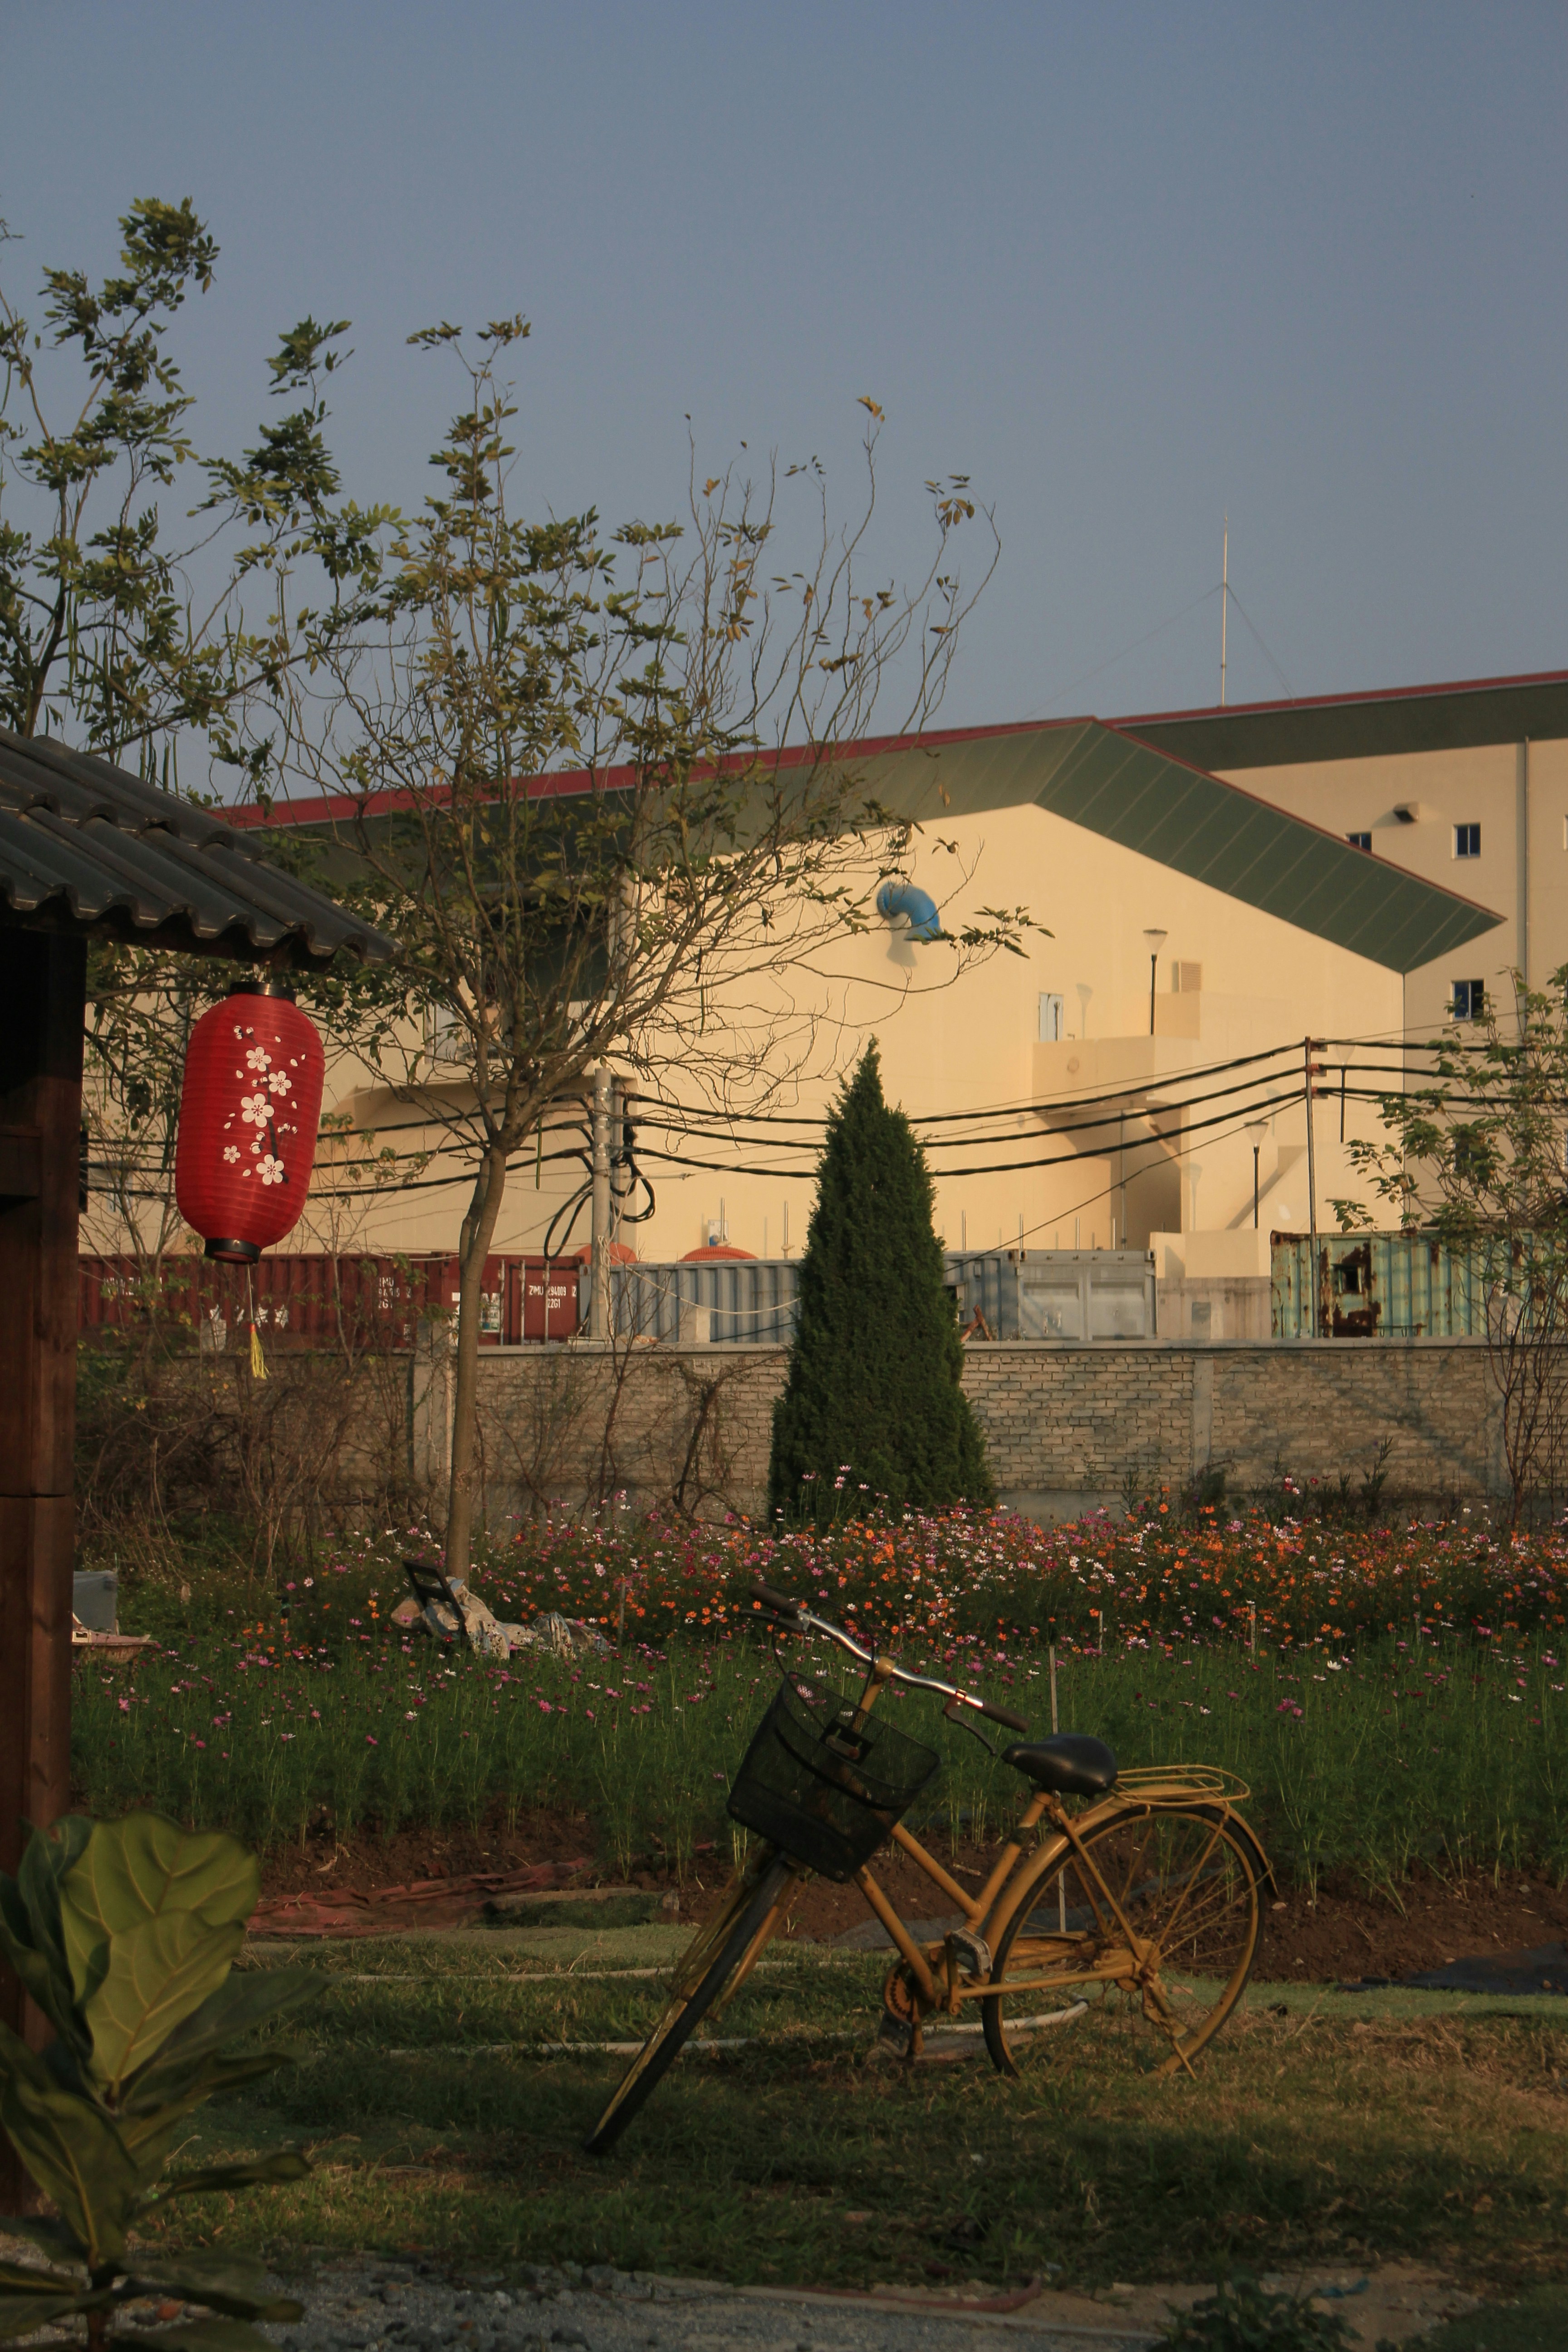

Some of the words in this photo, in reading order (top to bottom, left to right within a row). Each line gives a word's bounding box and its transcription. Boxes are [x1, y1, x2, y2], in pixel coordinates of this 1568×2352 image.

[529, 1285, 544, 1296] ZIMU
[548, 1285, 567, 1296] 294009
[548, 1298, 561, 1308] 22G1
